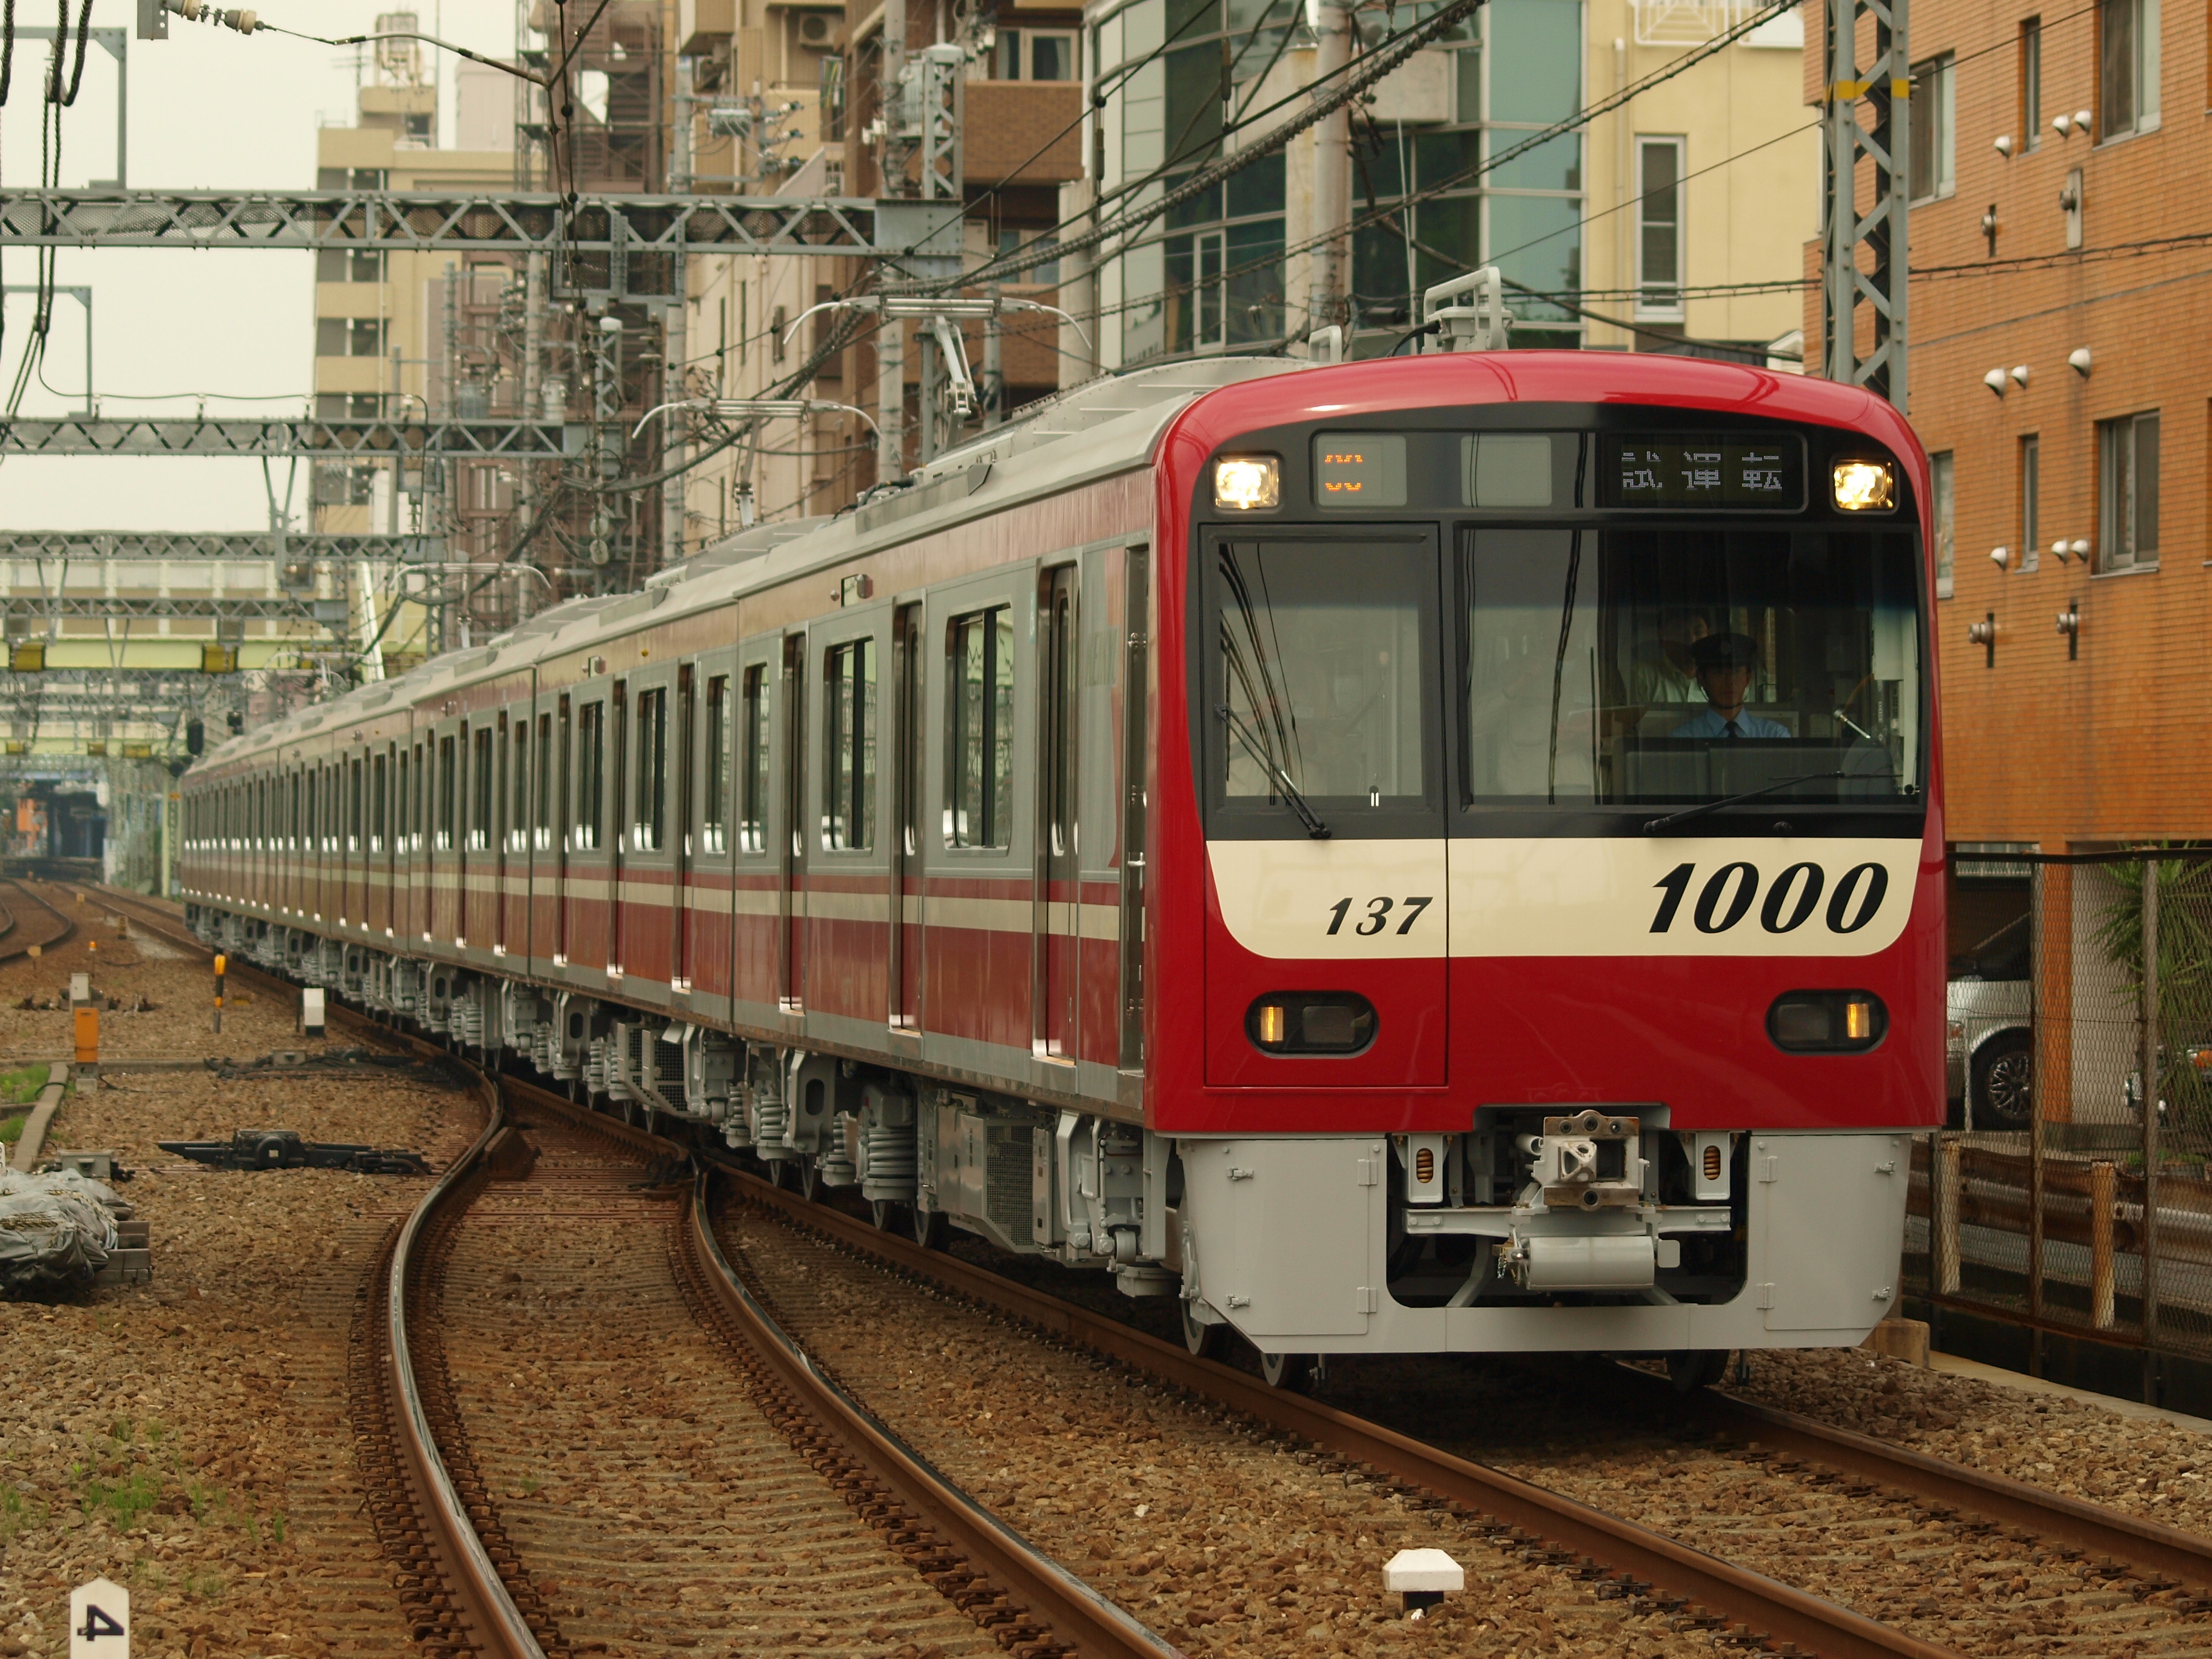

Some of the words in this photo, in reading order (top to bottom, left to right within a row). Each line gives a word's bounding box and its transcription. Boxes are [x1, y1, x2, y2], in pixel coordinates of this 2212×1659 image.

[1326, 896, 1433, 936] 137
[1649, 861, 1889, 934] 1000
[77, 1604, 124, 1641] 4
